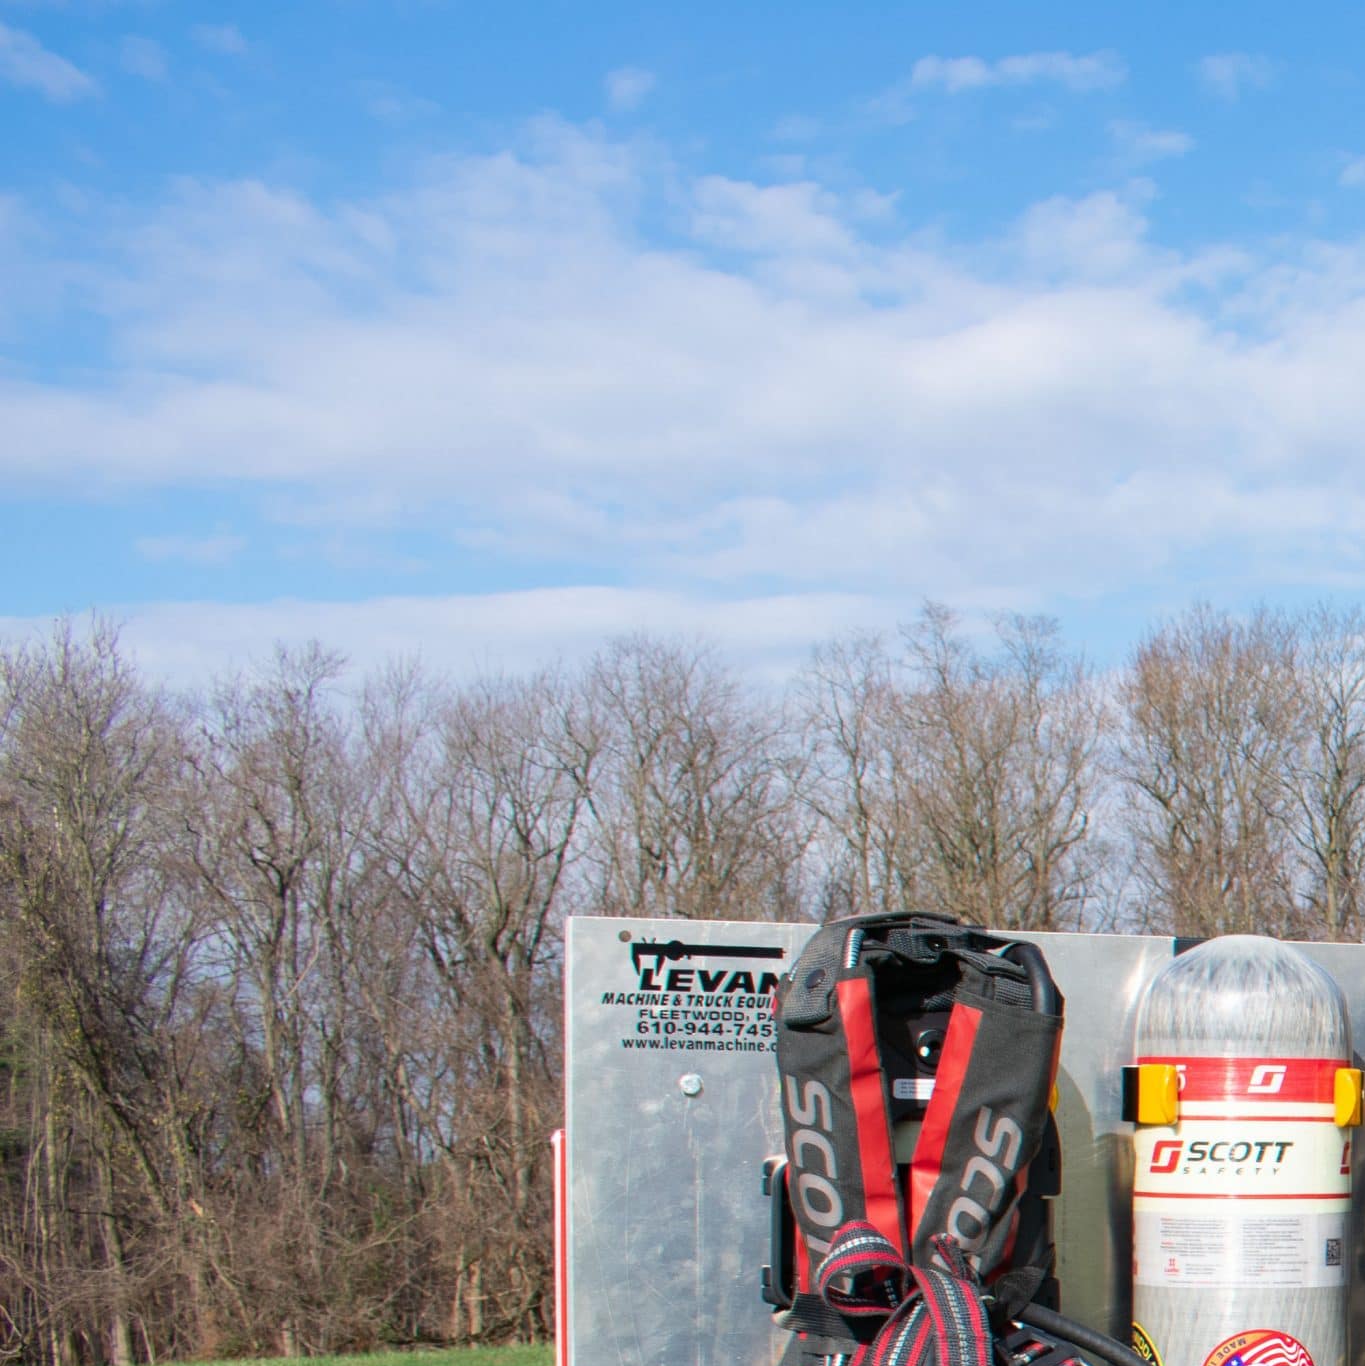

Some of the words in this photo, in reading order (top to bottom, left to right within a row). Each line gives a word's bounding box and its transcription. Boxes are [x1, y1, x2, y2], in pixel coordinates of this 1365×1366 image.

[601, 992, 669, 1006] MACHINE
[672, 994, 682, 1006] &
[687, 994, 733, 1008] TRUCK
[636, 1021, 777, 1037] 610-944-745
[1186, 1141, 1293, 1163] SCOTT
[1183, 1166, 1280, 1176] SAFETY
[785, 1074, 852, 1290] SCOT
[1215, 1337, 1247, 1360] MADE
